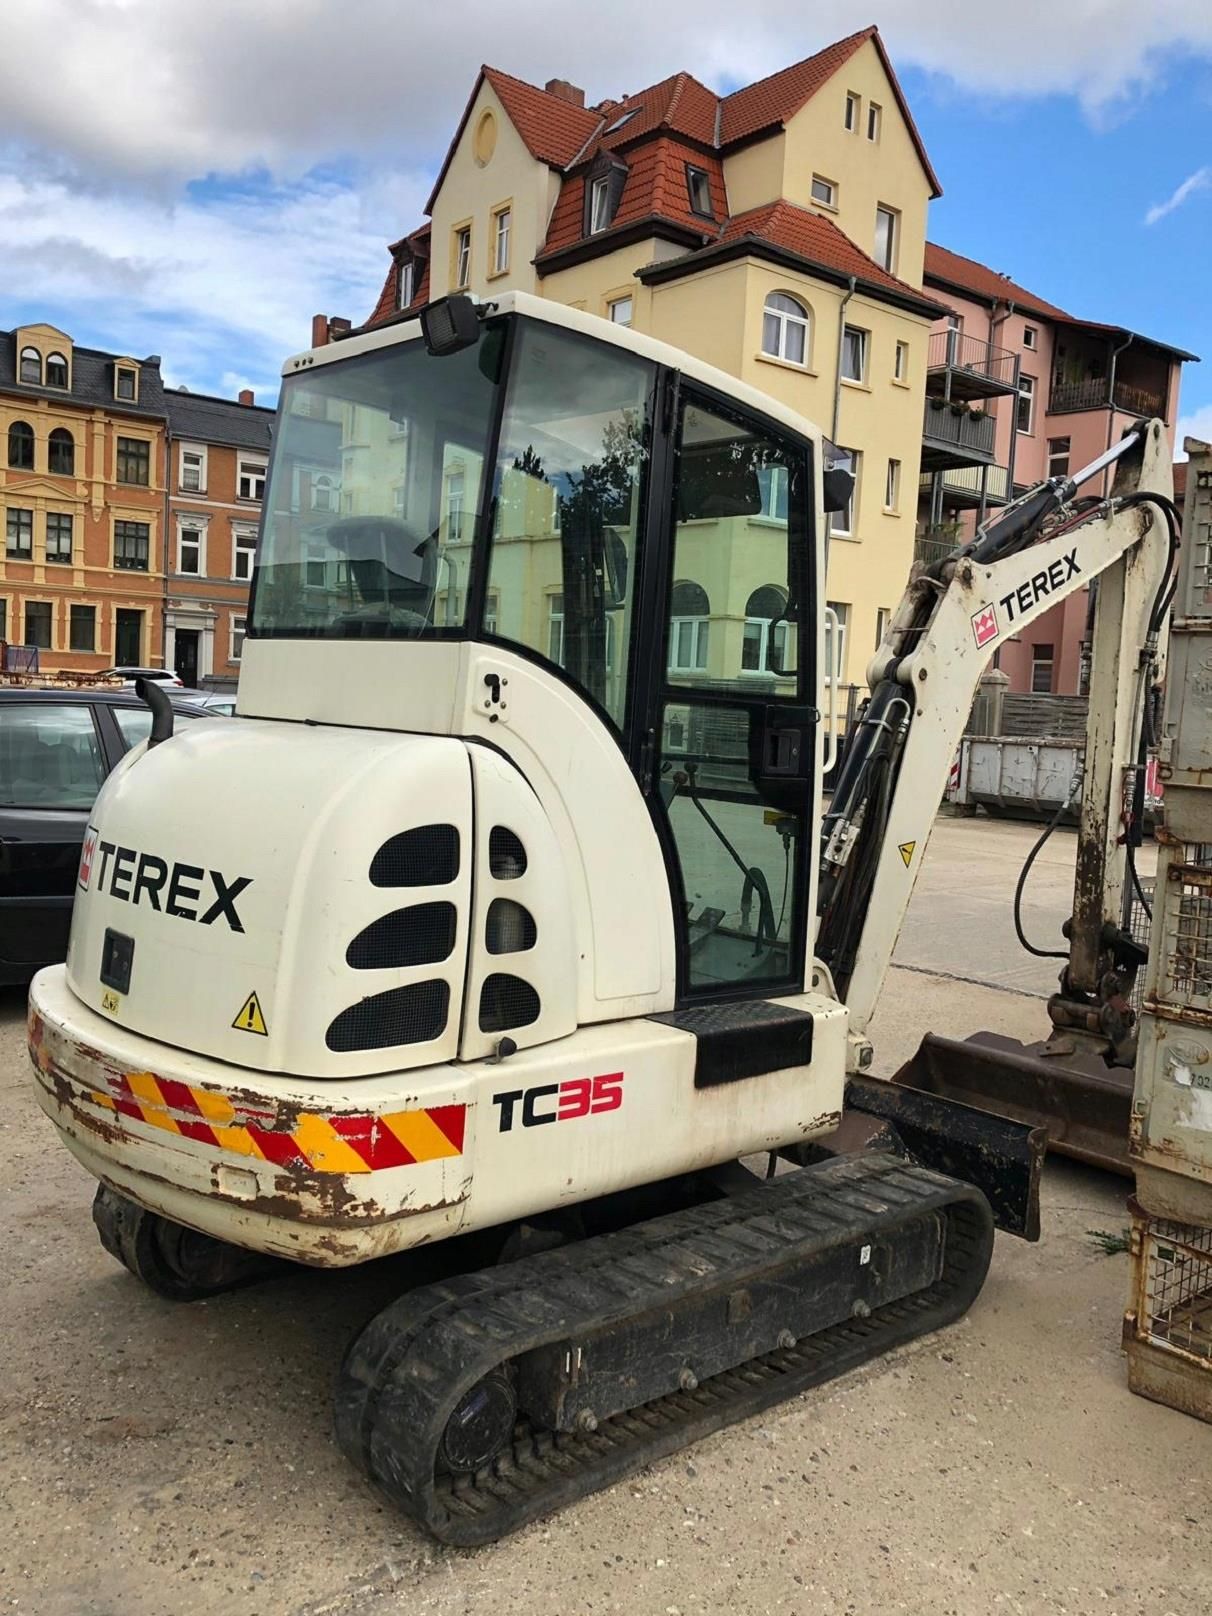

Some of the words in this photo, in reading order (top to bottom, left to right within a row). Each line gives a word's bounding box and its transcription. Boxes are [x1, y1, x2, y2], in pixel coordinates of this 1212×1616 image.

[1000, 547, 1082, 622] TEREX
[98, 841, 254, 934] TEREX
[492, 1072, 625, 1133] TC35
